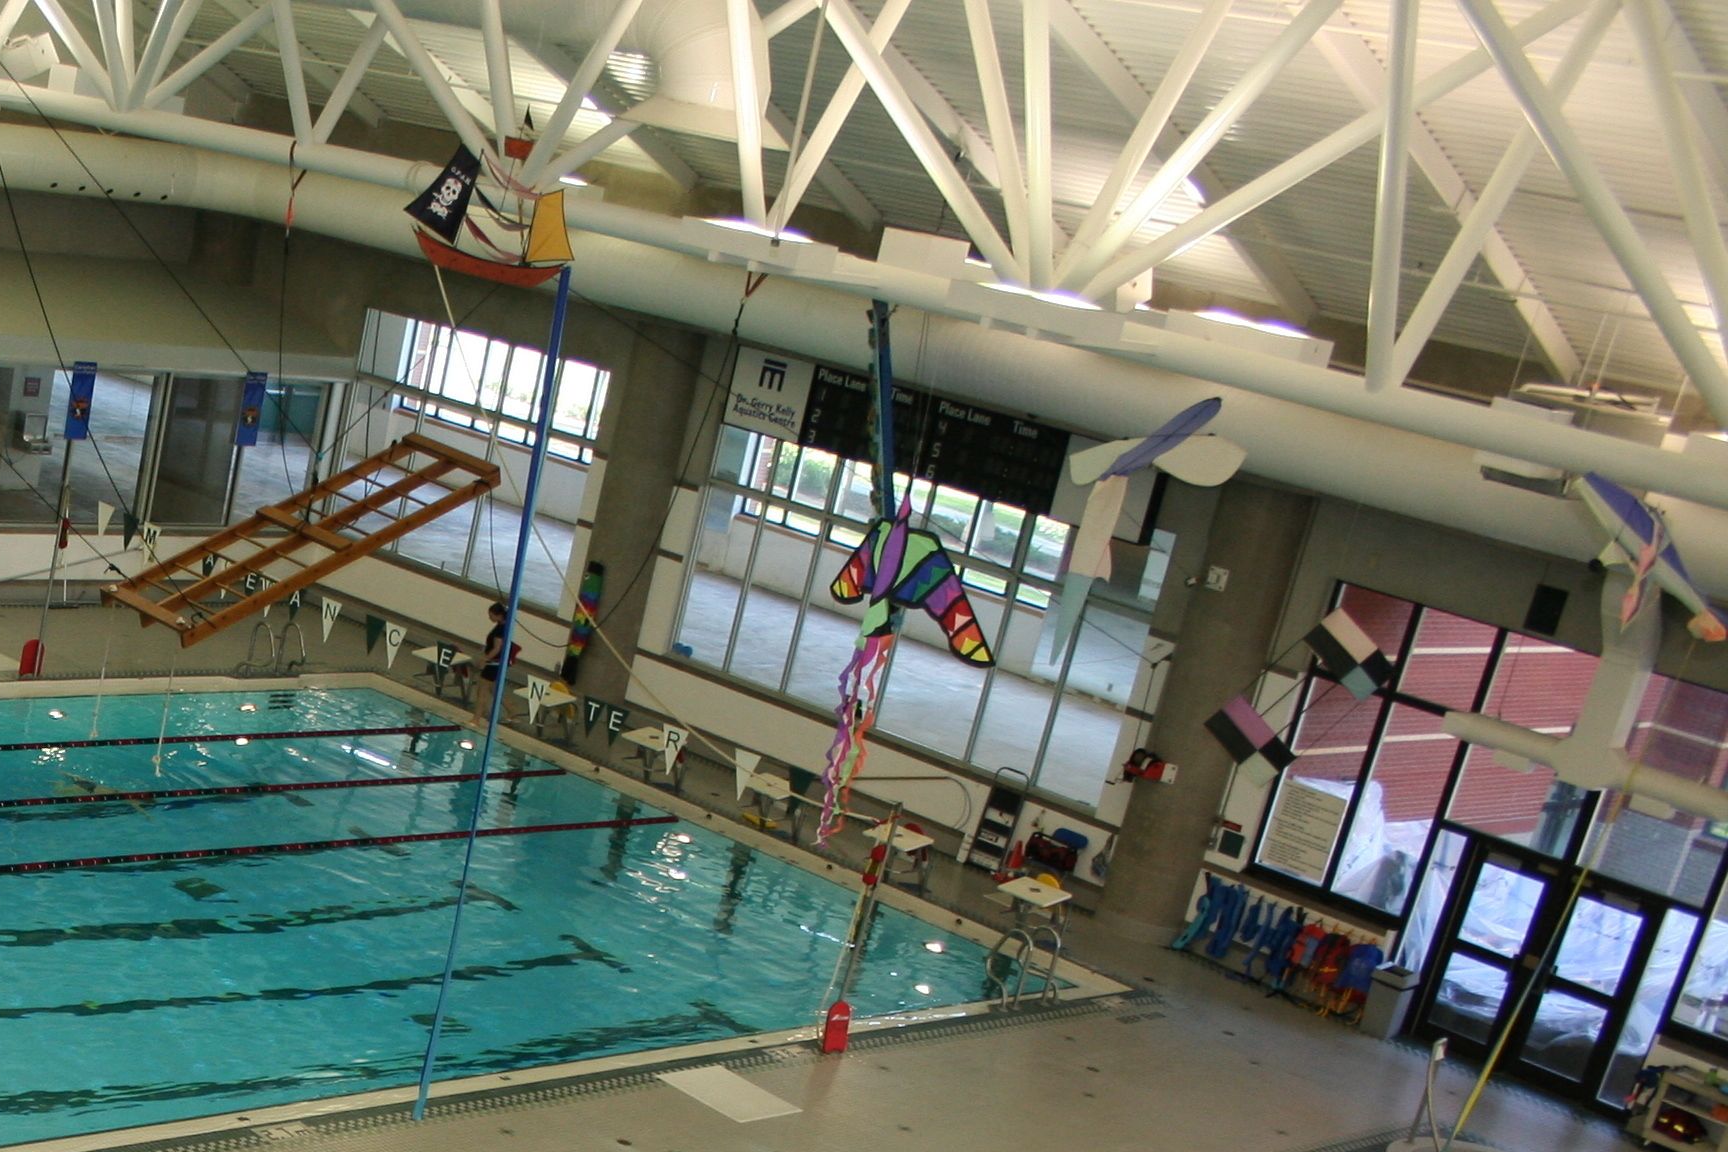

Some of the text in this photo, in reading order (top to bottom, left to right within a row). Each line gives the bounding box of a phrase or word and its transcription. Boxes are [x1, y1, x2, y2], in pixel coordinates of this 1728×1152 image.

[818, 368, 913, 405] Place Lane Time
[733, 404, 796, 428] Aquatics Centre
[810, 408, 821, 424] 2
[938, 401, 1038, 439] Place Lane Time
[806, 430, 817, 444] 3
[931, 442, 942, 458] 5
[925, 464, 937, 479] 6
